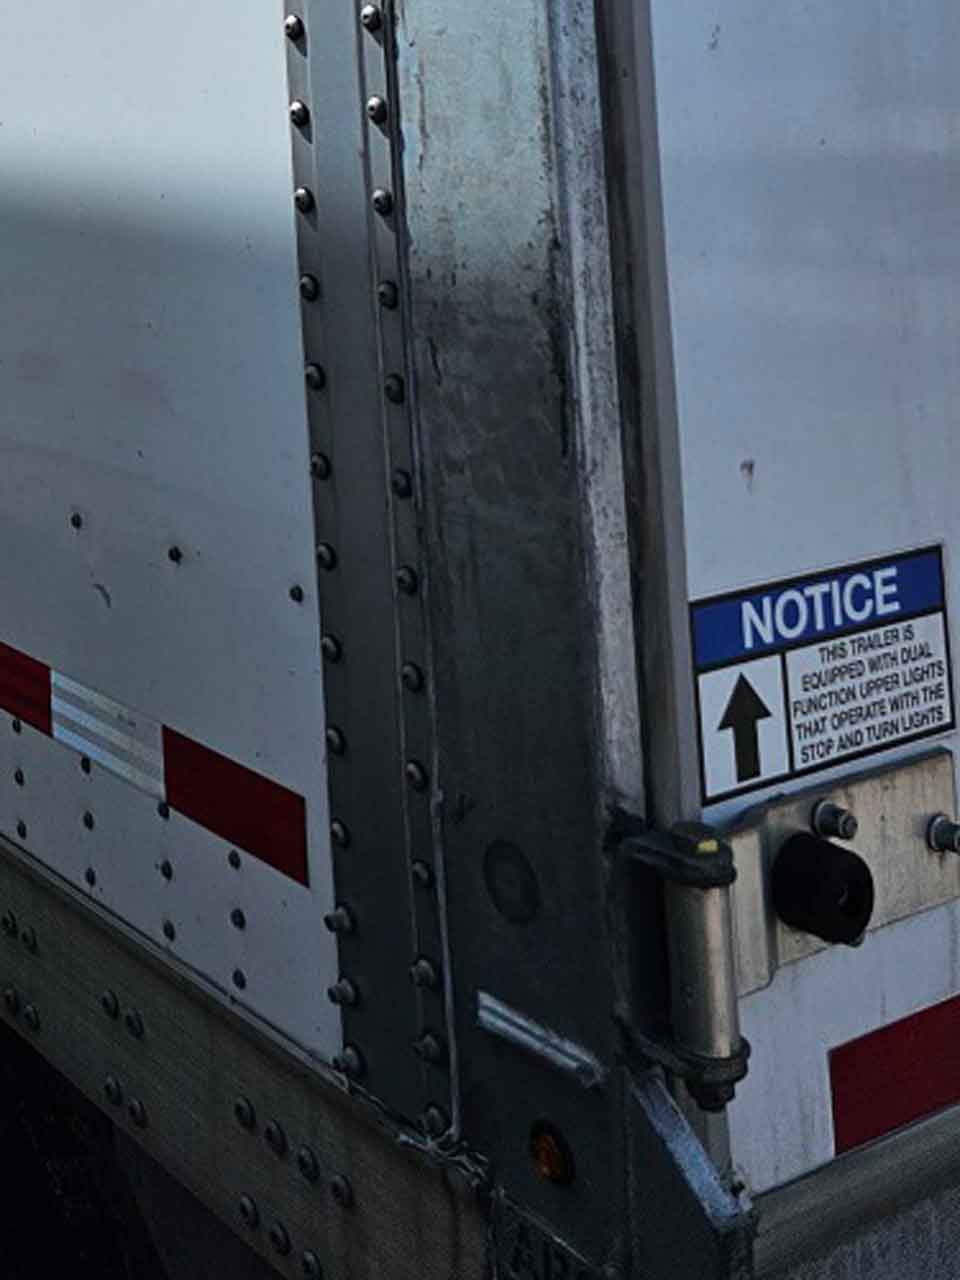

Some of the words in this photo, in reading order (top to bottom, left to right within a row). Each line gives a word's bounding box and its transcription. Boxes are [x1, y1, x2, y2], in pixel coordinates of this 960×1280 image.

[741, 566, 901, 649] NOTICE
[802, 659, 865, 692] EQUIPPED
[868, 652, 899, 673] WITH
[901, 642, 932, 664] DUAL
[818, 642, 848, 664] THIS
[850, 628, 900, 655] TRAILER
[903, 624, 915, 641] IS
[793, 685, 857, 718] FUNCTION
[860, 673, 900, 699] UPPER
[903, 660, 945, 687] LIGHTS
[796, 715, 827, 740] THAT
[831, 698, 886, 730] OPERATE
[888, 690, 920, 711] WITH
[922, 683, 945, 704] THE
[800, 738, 834, 763] STOP
[837, 729, 863, 752] AND
[865, 719, 899, 741] TURN
[902, 705, 944, 730] LIGHTS
